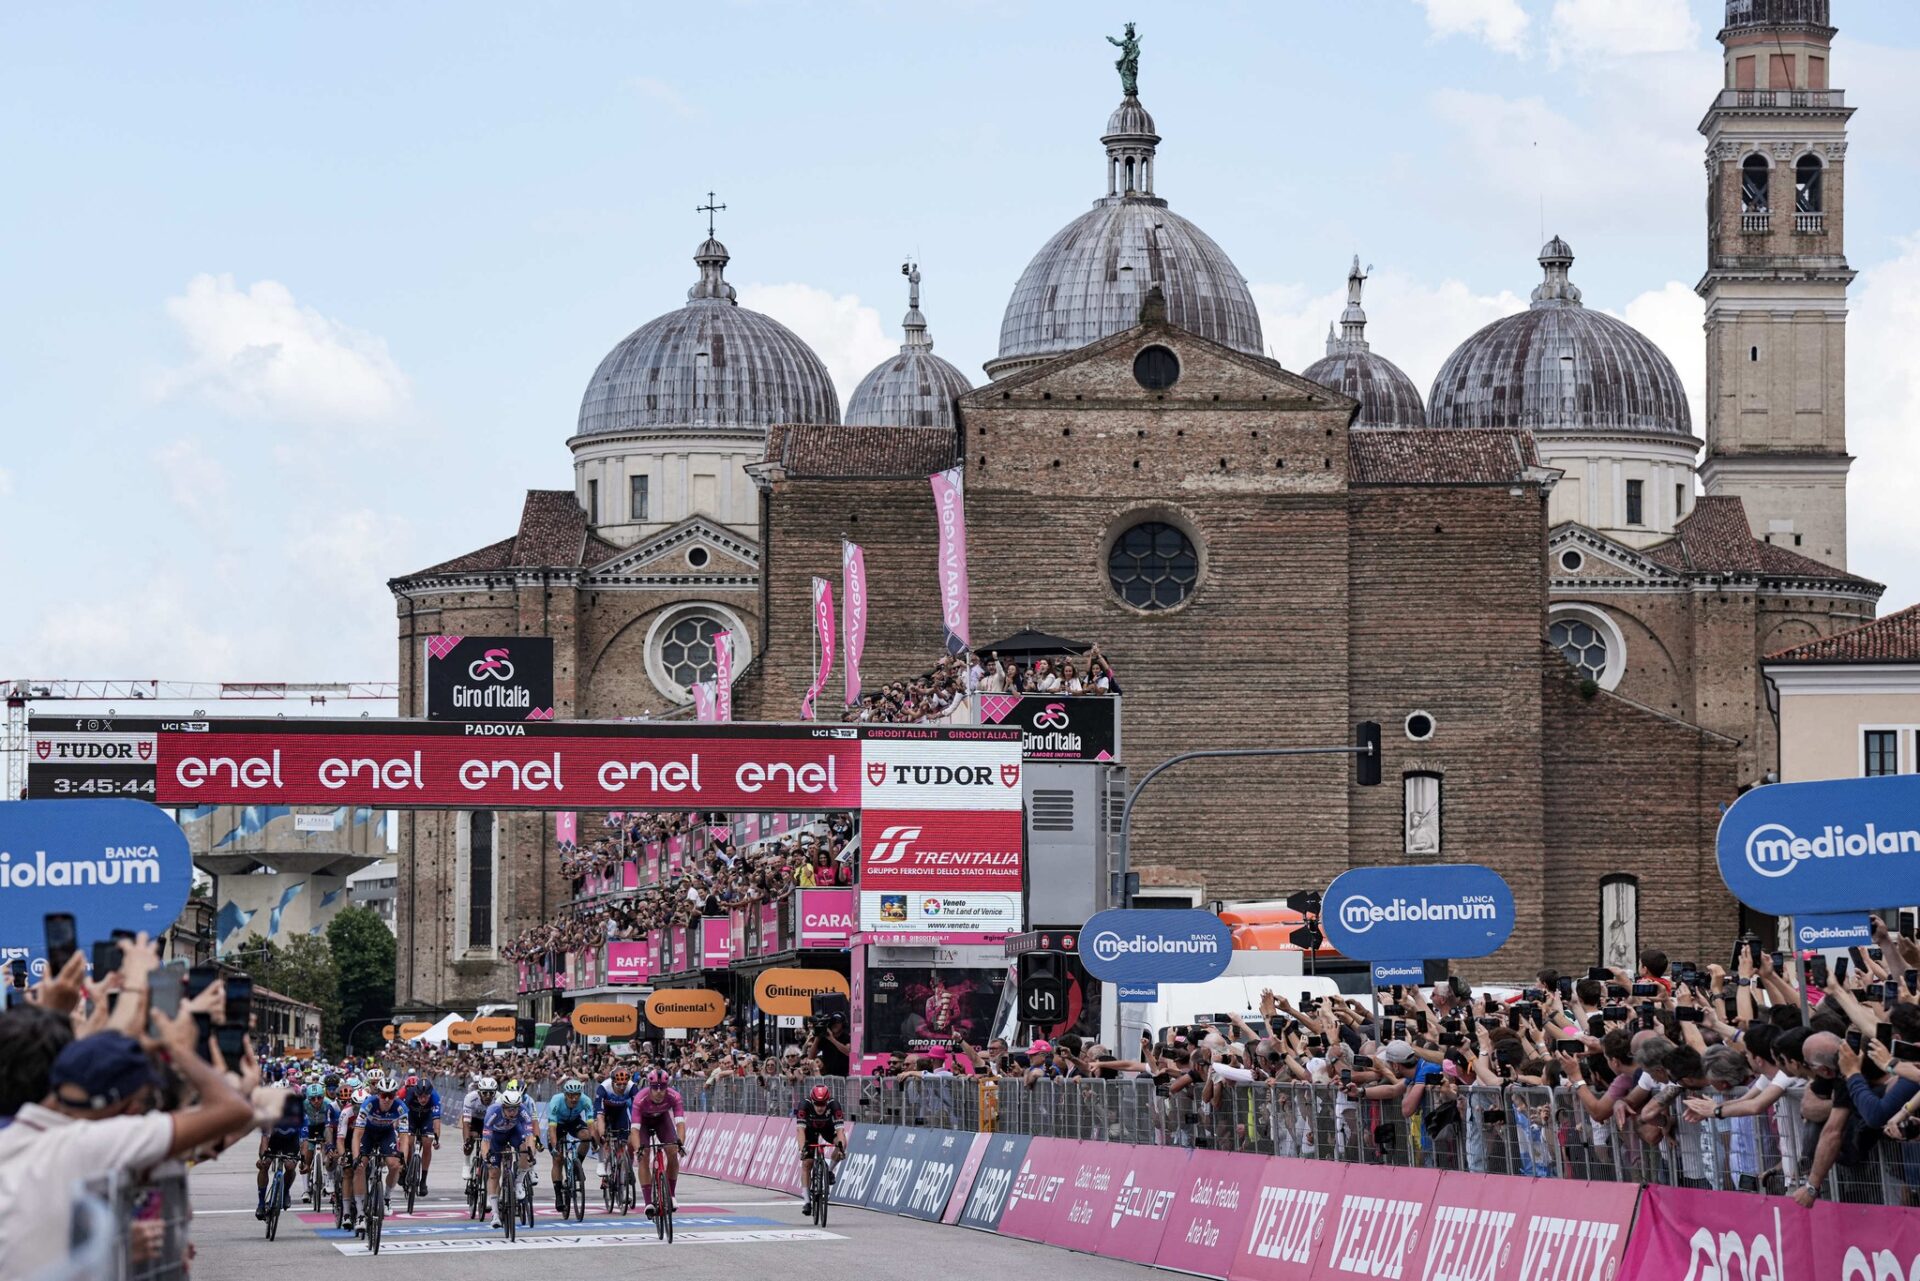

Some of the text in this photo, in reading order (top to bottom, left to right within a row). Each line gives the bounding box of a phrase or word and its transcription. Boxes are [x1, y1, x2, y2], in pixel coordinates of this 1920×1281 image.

[453, 685, 530, 708] Giro d'Italia
[161, 723, 179, 731] UCI
[465, 724, 525, 736] PADOVA
[867, 730, 1019, 740] GIRODITALIA.IT GIRODITALIA.IT
[56, 743, 133, 759] TUDOR
[177, 750, 283, 787] enel
[319, 751, 424, 789] enel
[459, 753, 563, 790] enel
[598, 754, 701, 791] enel
[736, 755, 837, 792] enel
[893, 765, 994, 786] TUDOR
[54, 778, 156, 794] 3:45:44
[1756, 823, 1920, 862] mediolan
[105, 846, 159, 859] BANCA
[914, 851, 1019, 865] TRENITALIA
[0, 851, 160, 888] iolanum
[867, 867, 899, 875] GRUPPO
[900, 867, 935, 875] FERROVIE
[985, 868, 1019, 876] ITALIANE
[943, 899, 966, 907] Veneto
[1462, 895, 1495, 904] BANCA
[981, 908, 1003, 916] Venice
[1346, 898, 1496, 922] mediolanum
[805, 913, 852, 928] CARA
[927, 922, 980, 930] www.veneto.eu
[984, 935, 1005, 943] #girod
[1099, 934, 1218, 953] mediolanum
[617, 957, 649, 968] RAFF
[655, 1002, 708, 1014] Continental
[579, 1014, 625, 1024] Continental
[785, 1017, 796, 1026] 10
